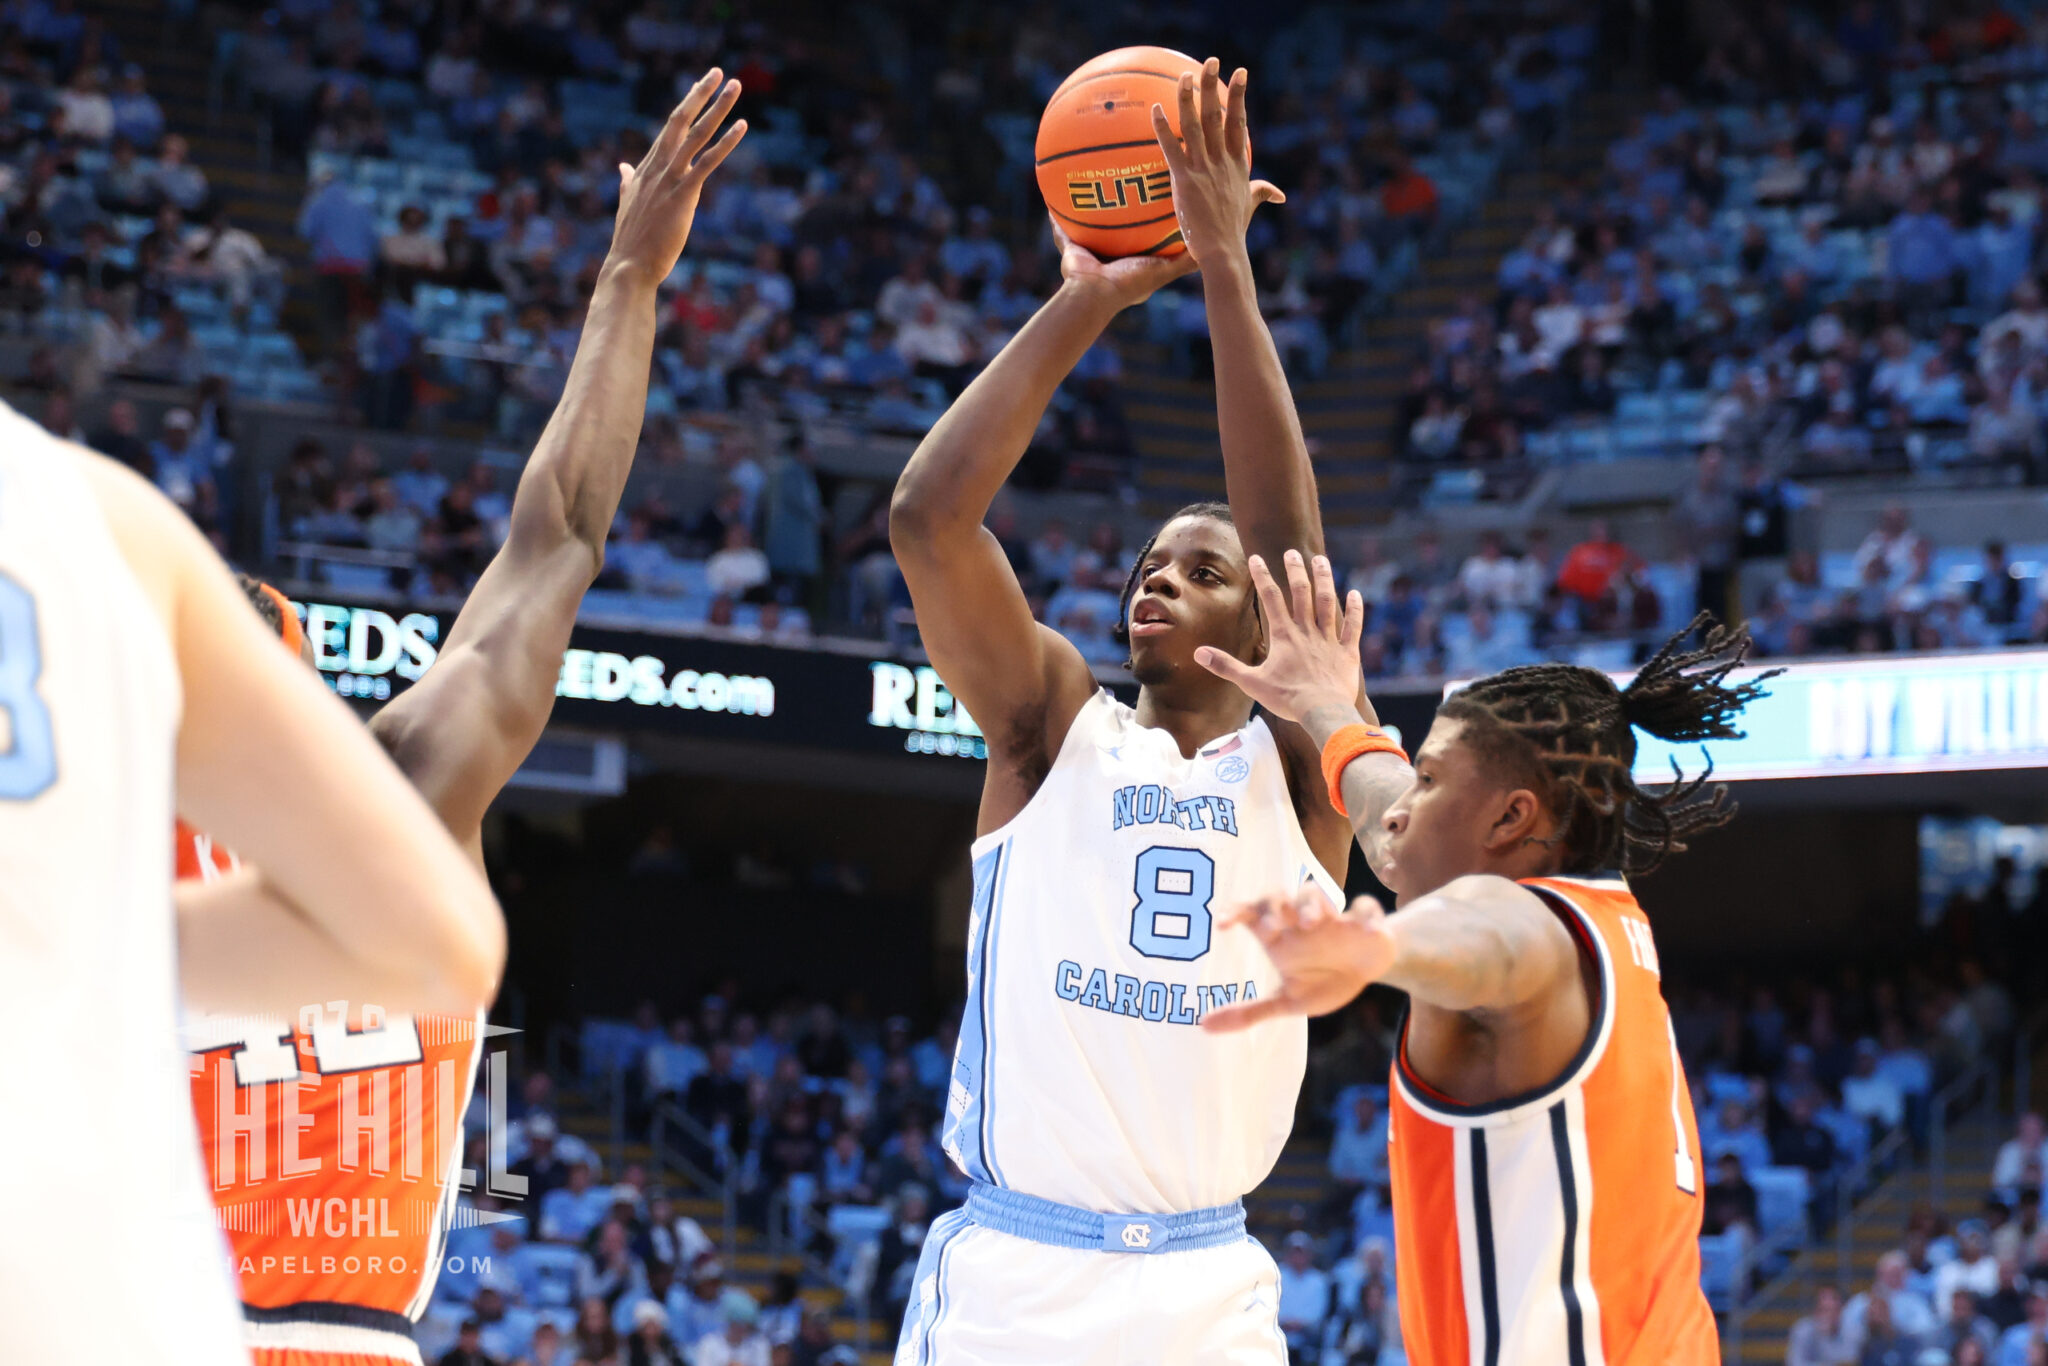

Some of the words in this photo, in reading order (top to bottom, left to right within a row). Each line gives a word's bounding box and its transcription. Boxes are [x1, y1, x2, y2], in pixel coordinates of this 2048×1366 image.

[1066, 160, 1170, 179] HAMPIONSHIP
[1068, 170, 1173, 212] ELITE
[290, 601, 439, 683] EDS
[555, 649, 775, 717] EDS.com
[1113, 784, 1239, 838] NORTH
[1129, 845, 1215, 962] 8
